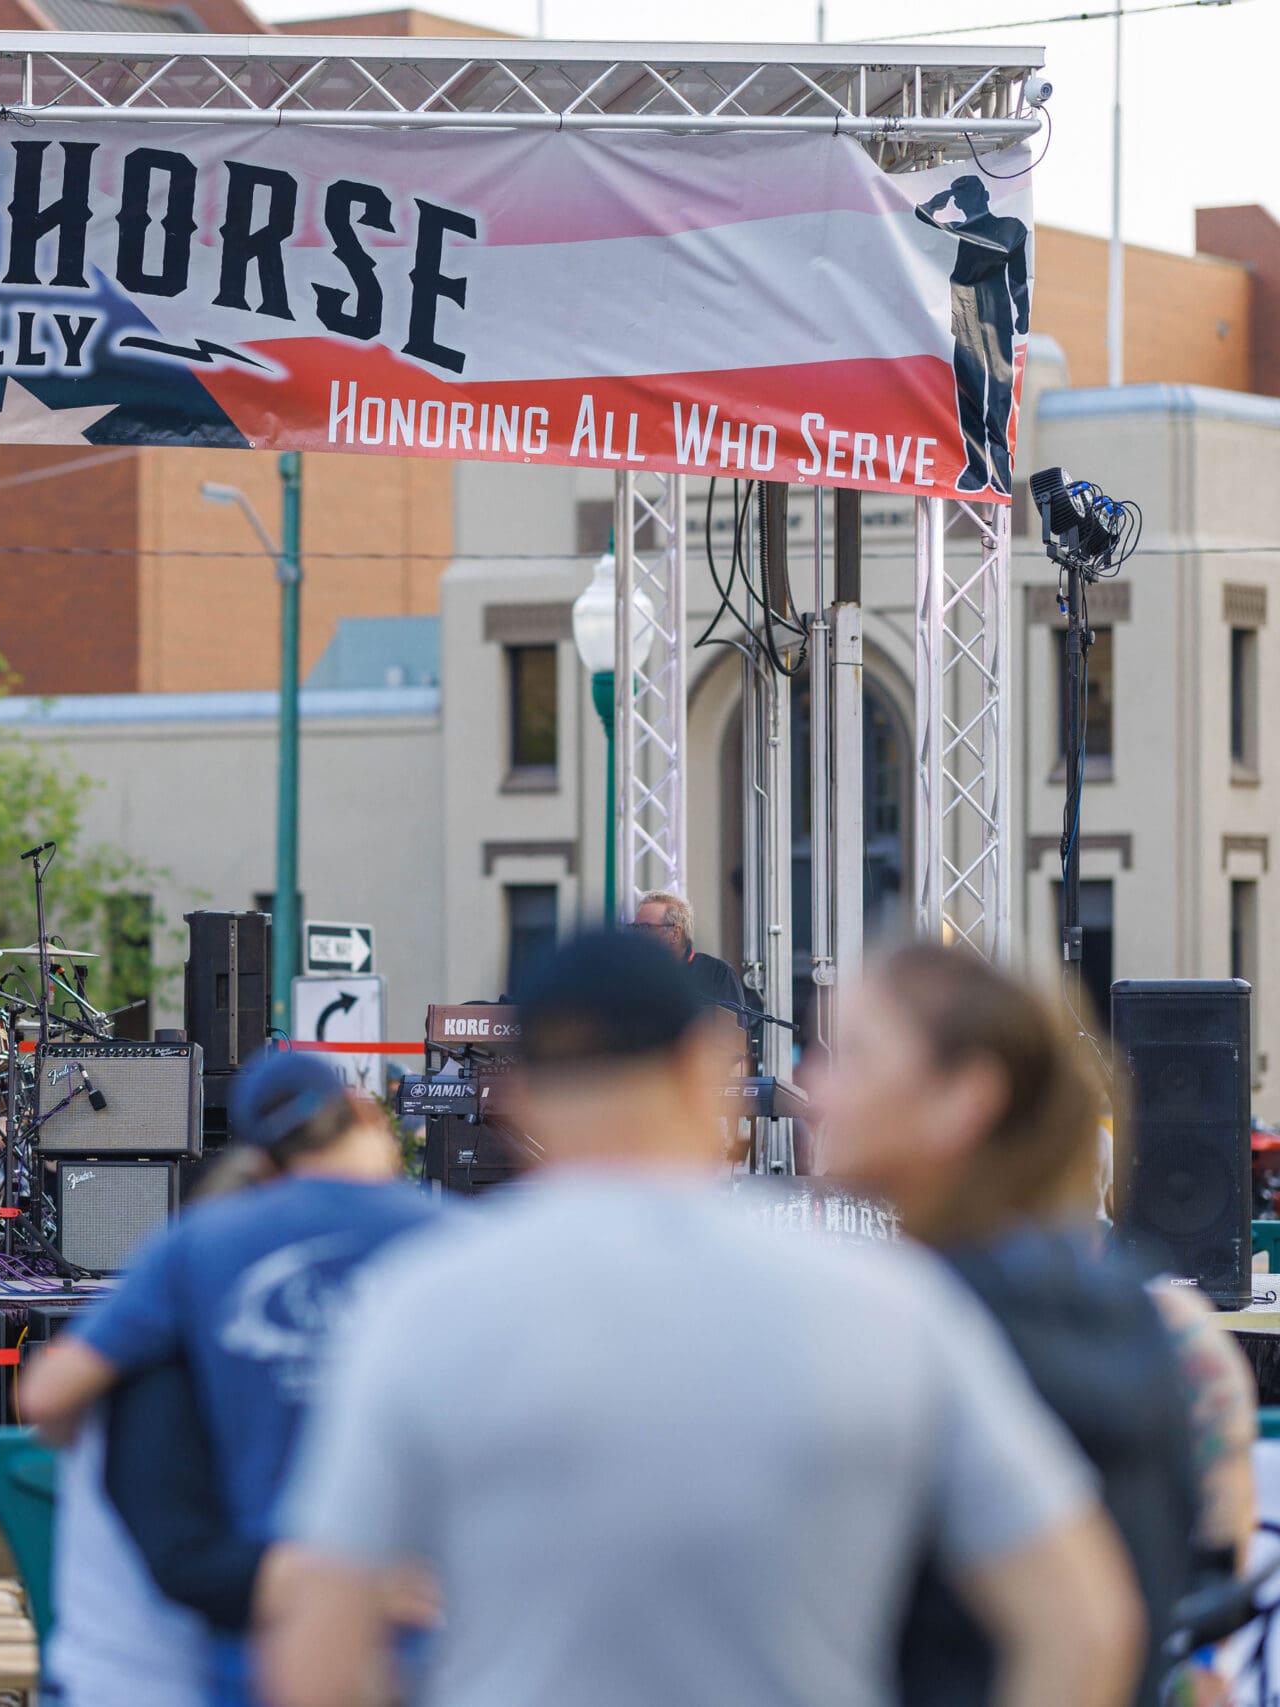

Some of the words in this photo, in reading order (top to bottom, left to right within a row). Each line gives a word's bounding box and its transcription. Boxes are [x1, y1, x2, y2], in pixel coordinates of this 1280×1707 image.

[1, 140, 477, 374] HORSE
[444, 1018, 490, 1036] KORG
[427, 1084, 470, 1097] YAMA
